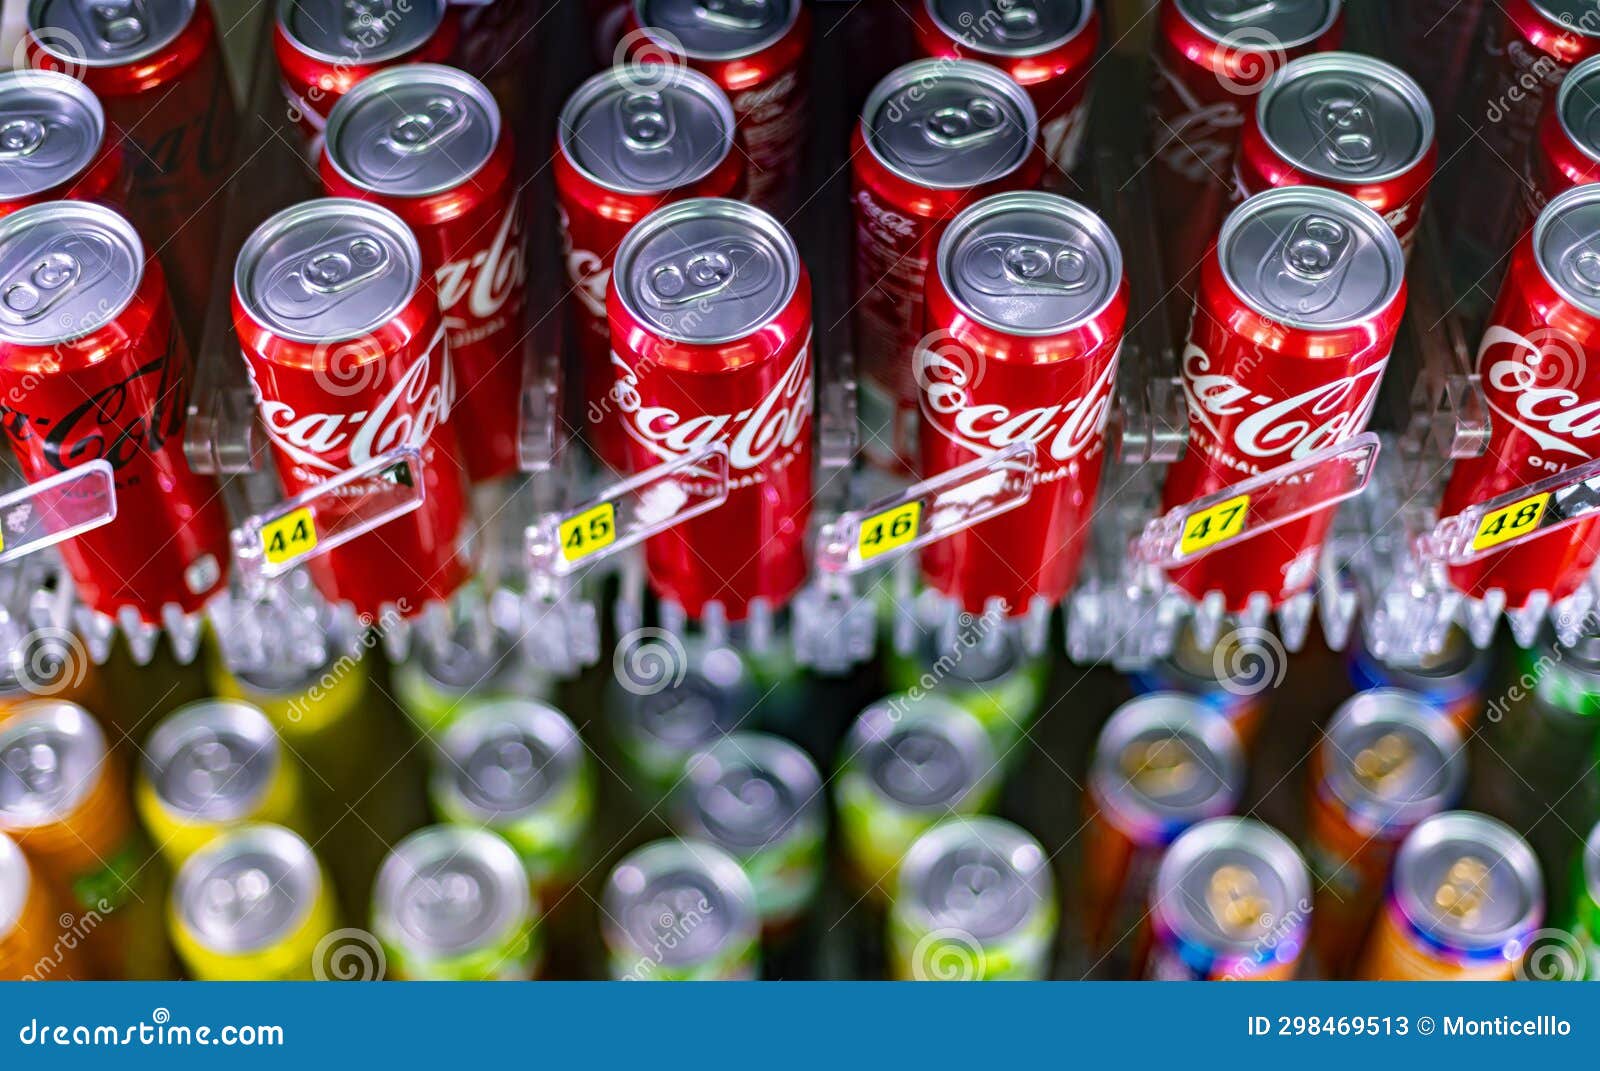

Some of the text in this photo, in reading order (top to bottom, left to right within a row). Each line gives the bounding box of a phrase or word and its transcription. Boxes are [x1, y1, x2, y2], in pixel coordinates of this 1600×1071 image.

[268, 519, 309, 552] 44
[566, 513, 611, 548] 45
[863, 512, 912, 545] 46
[1188, 503, 1244, 539] 47
[1481, 502, 1540, 536] 48
